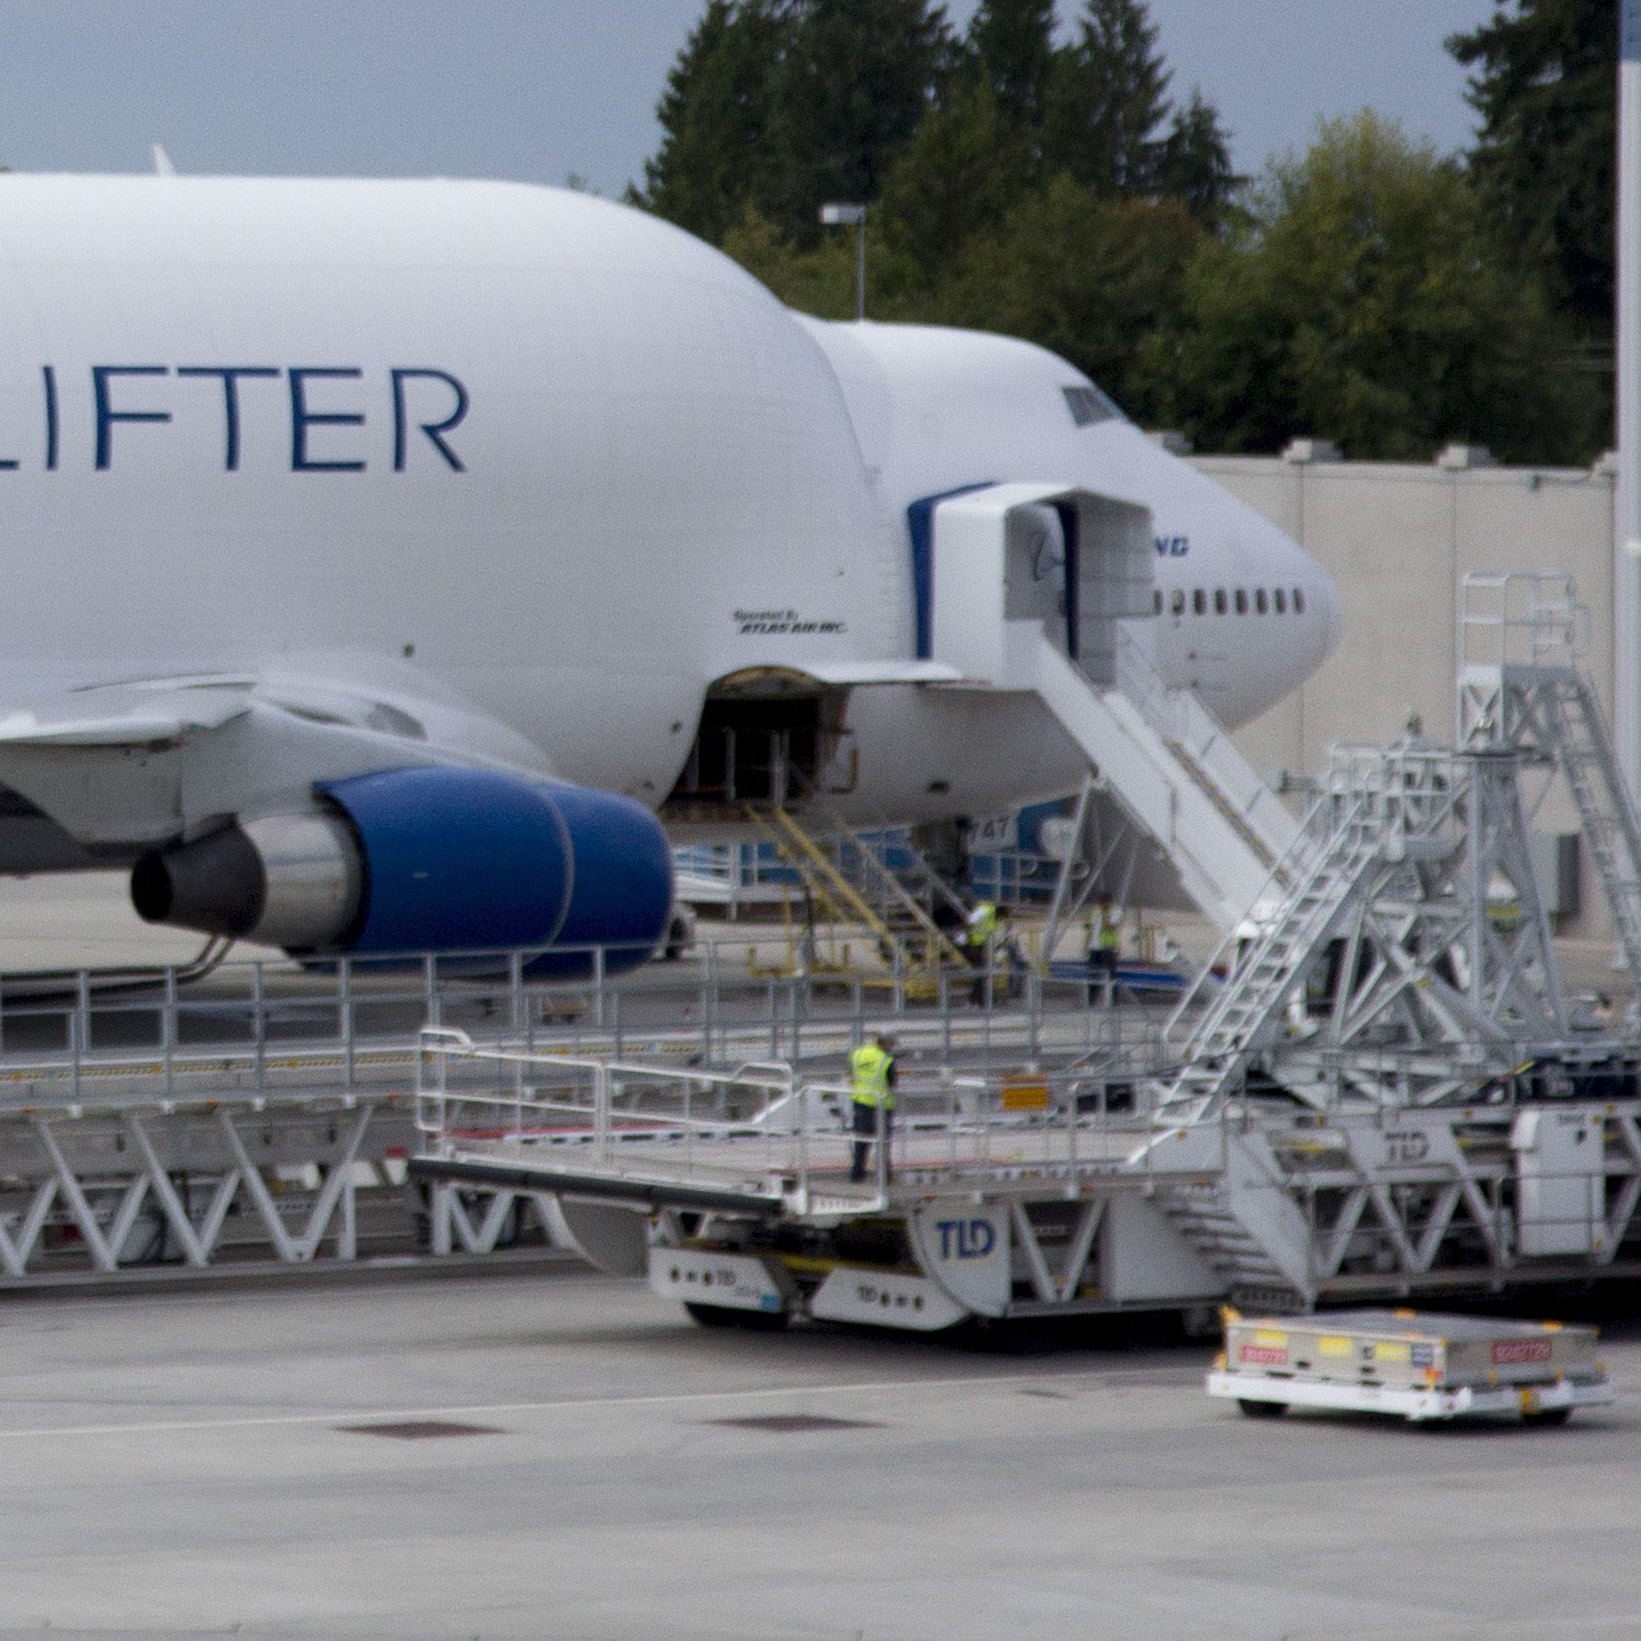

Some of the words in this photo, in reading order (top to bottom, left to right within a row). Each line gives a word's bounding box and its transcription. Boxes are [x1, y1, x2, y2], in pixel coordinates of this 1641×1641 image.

[739, 622, 790, 635] ATLAS
[790, 622, 818, 634] AIR
[1384, 1131, 1431, 1162] TLD
[935, 1219, 996, 1259] TLD
